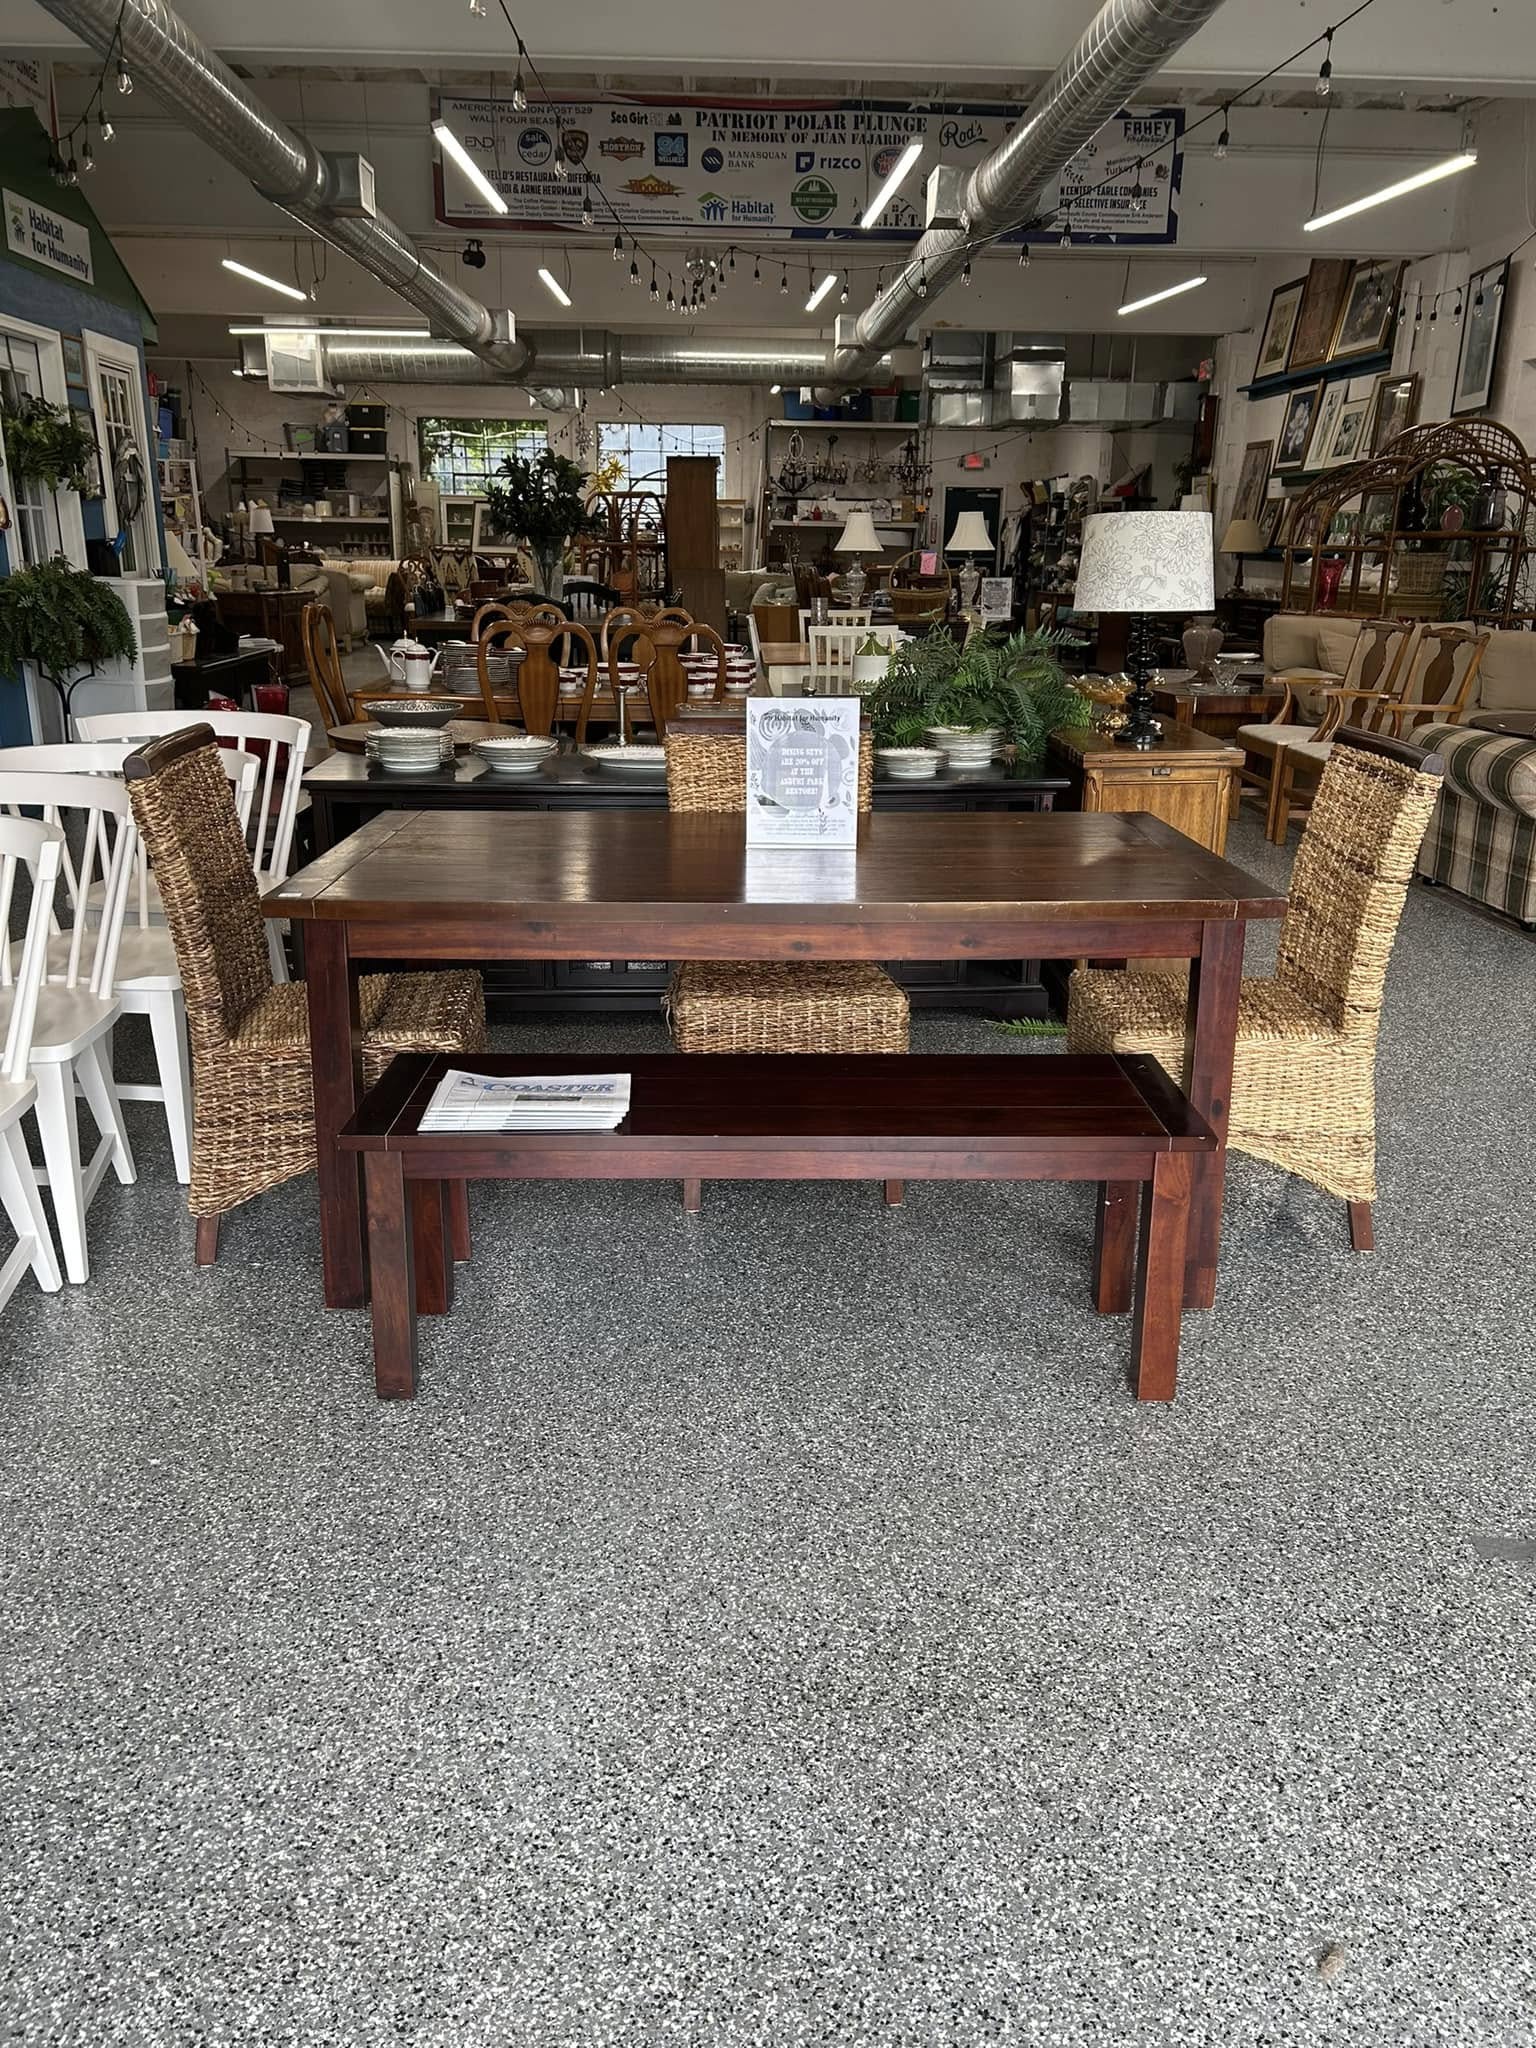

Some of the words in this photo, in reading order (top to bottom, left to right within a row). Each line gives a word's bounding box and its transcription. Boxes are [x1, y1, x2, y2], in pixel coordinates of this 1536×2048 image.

[452, 103, 506, 113] AMERICAN
[508, 104, 545, 114] LION
[547, 106, 573, 115] POST
[575, 106, 592, 115] 529
[500, 116, 527, 125] FOUR
[529, 116, 576, 125] SEASNS
[611, 111, 628, 124] Sea
[630, 112, 649, 125] Girt
[696, 111, 778, 130] PATRIOT
[784, 113, 847, 130] POLAR
[853, 114, 928, 133] PLUNGE
[939, 119, 988, 149] Rod's
[1123, 121, 1172, 137] FAHEY
[525, 133, 544, 143] salt
[712, 130, 726, 142] IN
[731, 131, 787, 143] MEMORY
[791, 132, 808, 144] OF
[812, 133, 847, 144] JUAN
[851, 134, 910, 146] FAJARDO
[521, 150, 548, 160] cedar
[728, 151, 788, 160] MANASQUAN
[728, 160, 755, 169] BANK
[820, 157, 862, 170] rizco
[521, 184, 541, 195] ARNIE
[543, 184, 582, 196] HERRMANN
[1066, 186, 1093, 197] CENTER
[1097, 187, 1119, 197] EARLE
[732, 200, 775, 215] Habitat
[1074, 199, 1109, 209] SELECTIVE
[1110, 199, 1147, 210] INSURCE
[28, 207, 64, 243] Habitat
[732, 214, 742, 223] for
[743, 214, 775, 225] Humanity
[32, 232, 46, 255] for
[48, 239, 89, 279] Humanity
[483, 1082, 615, 1094] COASTER
